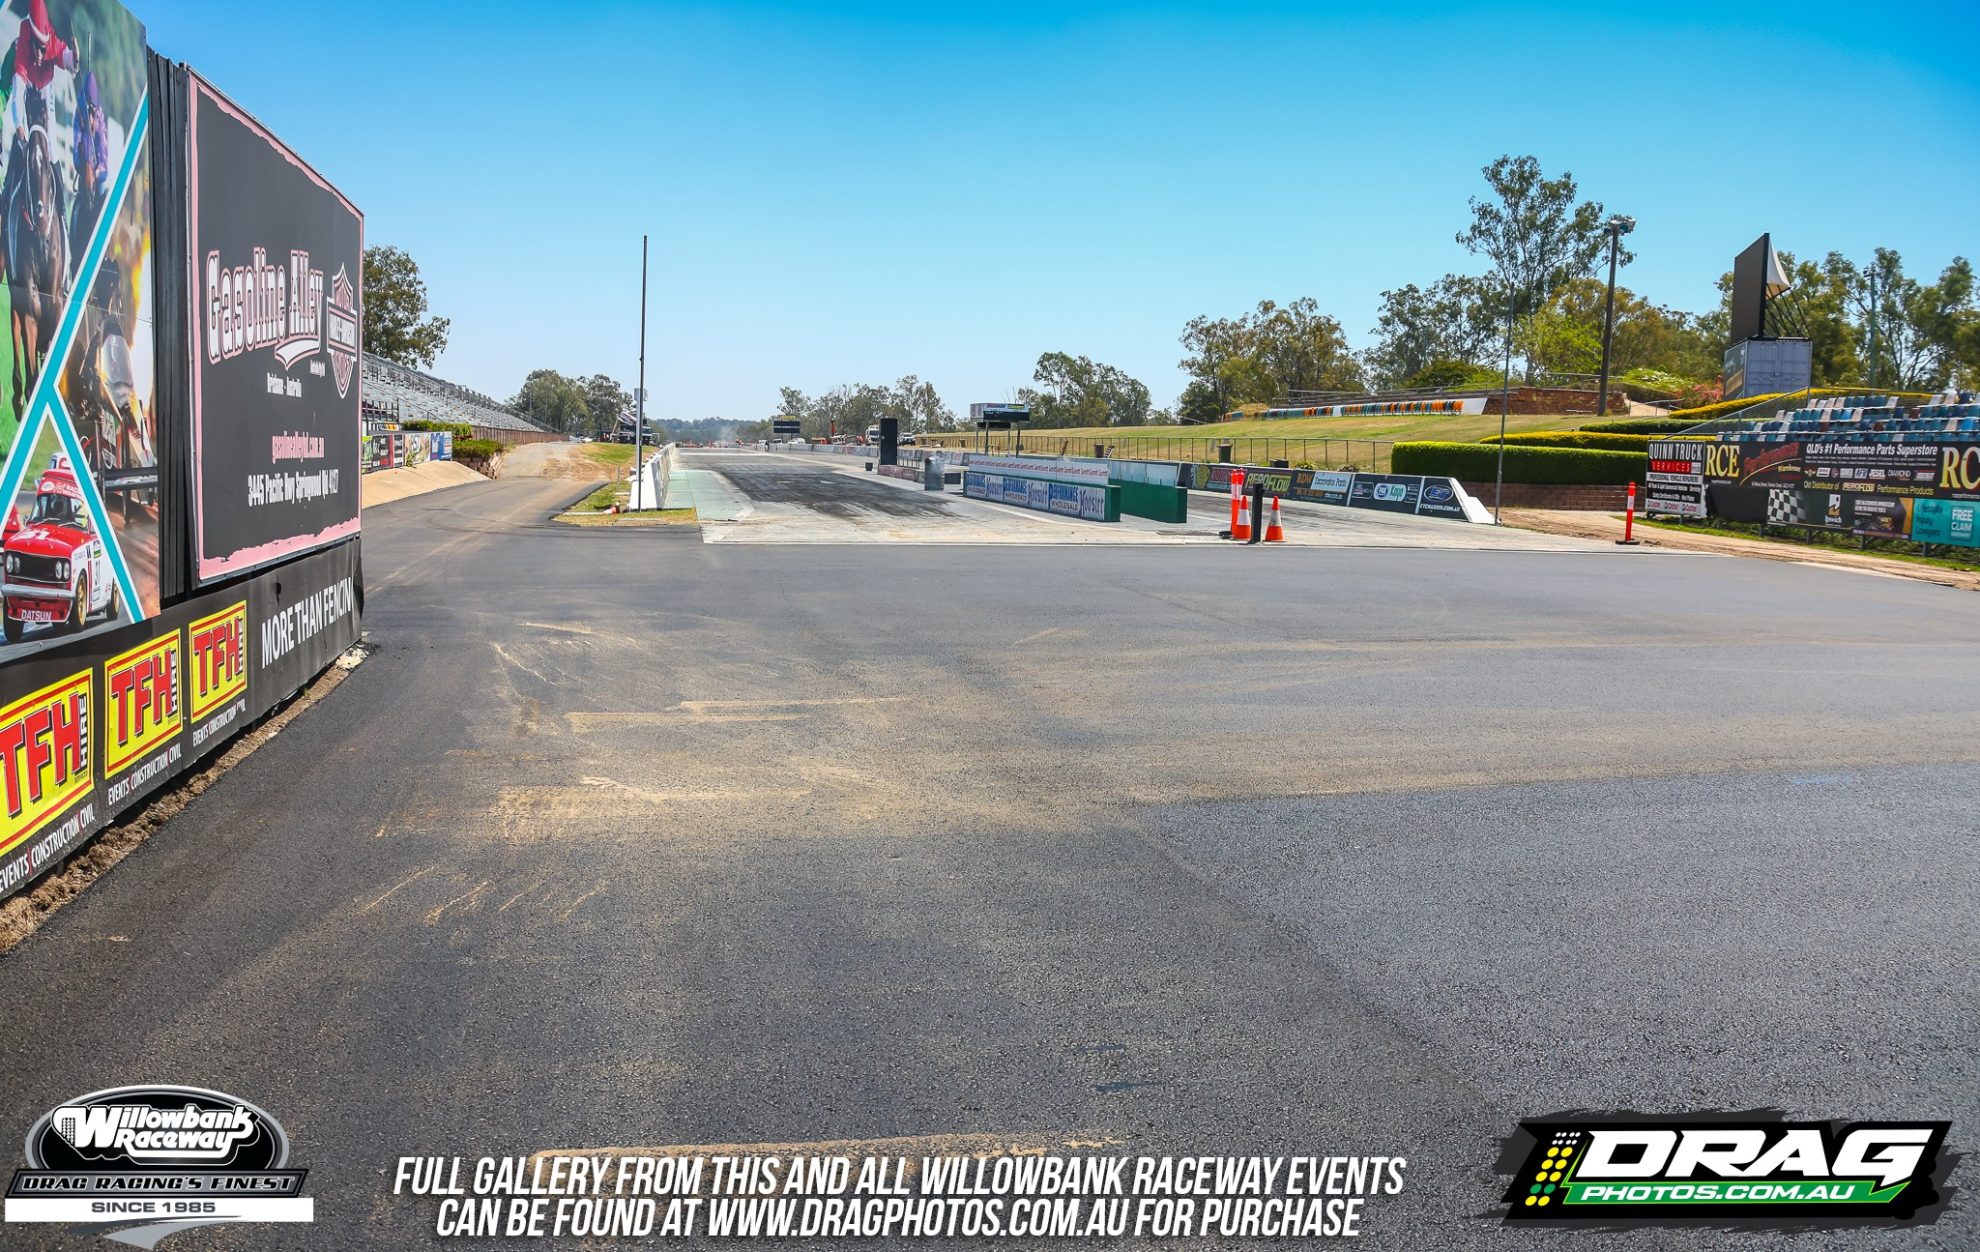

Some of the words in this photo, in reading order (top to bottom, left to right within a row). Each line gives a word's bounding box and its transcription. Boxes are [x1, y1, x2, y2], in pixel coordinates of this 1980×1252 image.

[206, 247, 286, 365] Gasoline
[289, 250, 324, 340] Alley
[1649, 443, 1674, 460] QUINN
[1675, 444, 1703, 461] TRUCK
[1704, 444, 1740, 478] RCE
[1824, 444, 1833, 454] #1
[1833, 443, 1875, 455] Performance
[1876, 444, 1895, 455] Parts
[1896, 444, 1938, 458] Superstore
[1051, 499, 1078, 510] WHOLESALE
[1952, 509, 1974, 521] FREE
[21, 609, 52, 621] DATSUN
[261, 606, 294, 669] MORE
[294, 591, 323, 645] THAN
[194, 617, 240, 696] TFH
[79, 694, 88, 768] HIRE
[110, 648, 172, 747] TFH
[0, 690, 81, 819] TFH
[108, 782, 130, 806] EVENTS
[130, 756, 169, 791] CONSTRUCTION
[169, 744, 182, 766] CIVIL
[0, 857, 30, 893] EVENTS
[31, 818, 80, 869] CONSTRUCTION
[80, 803, 95, 832] CIVIL
